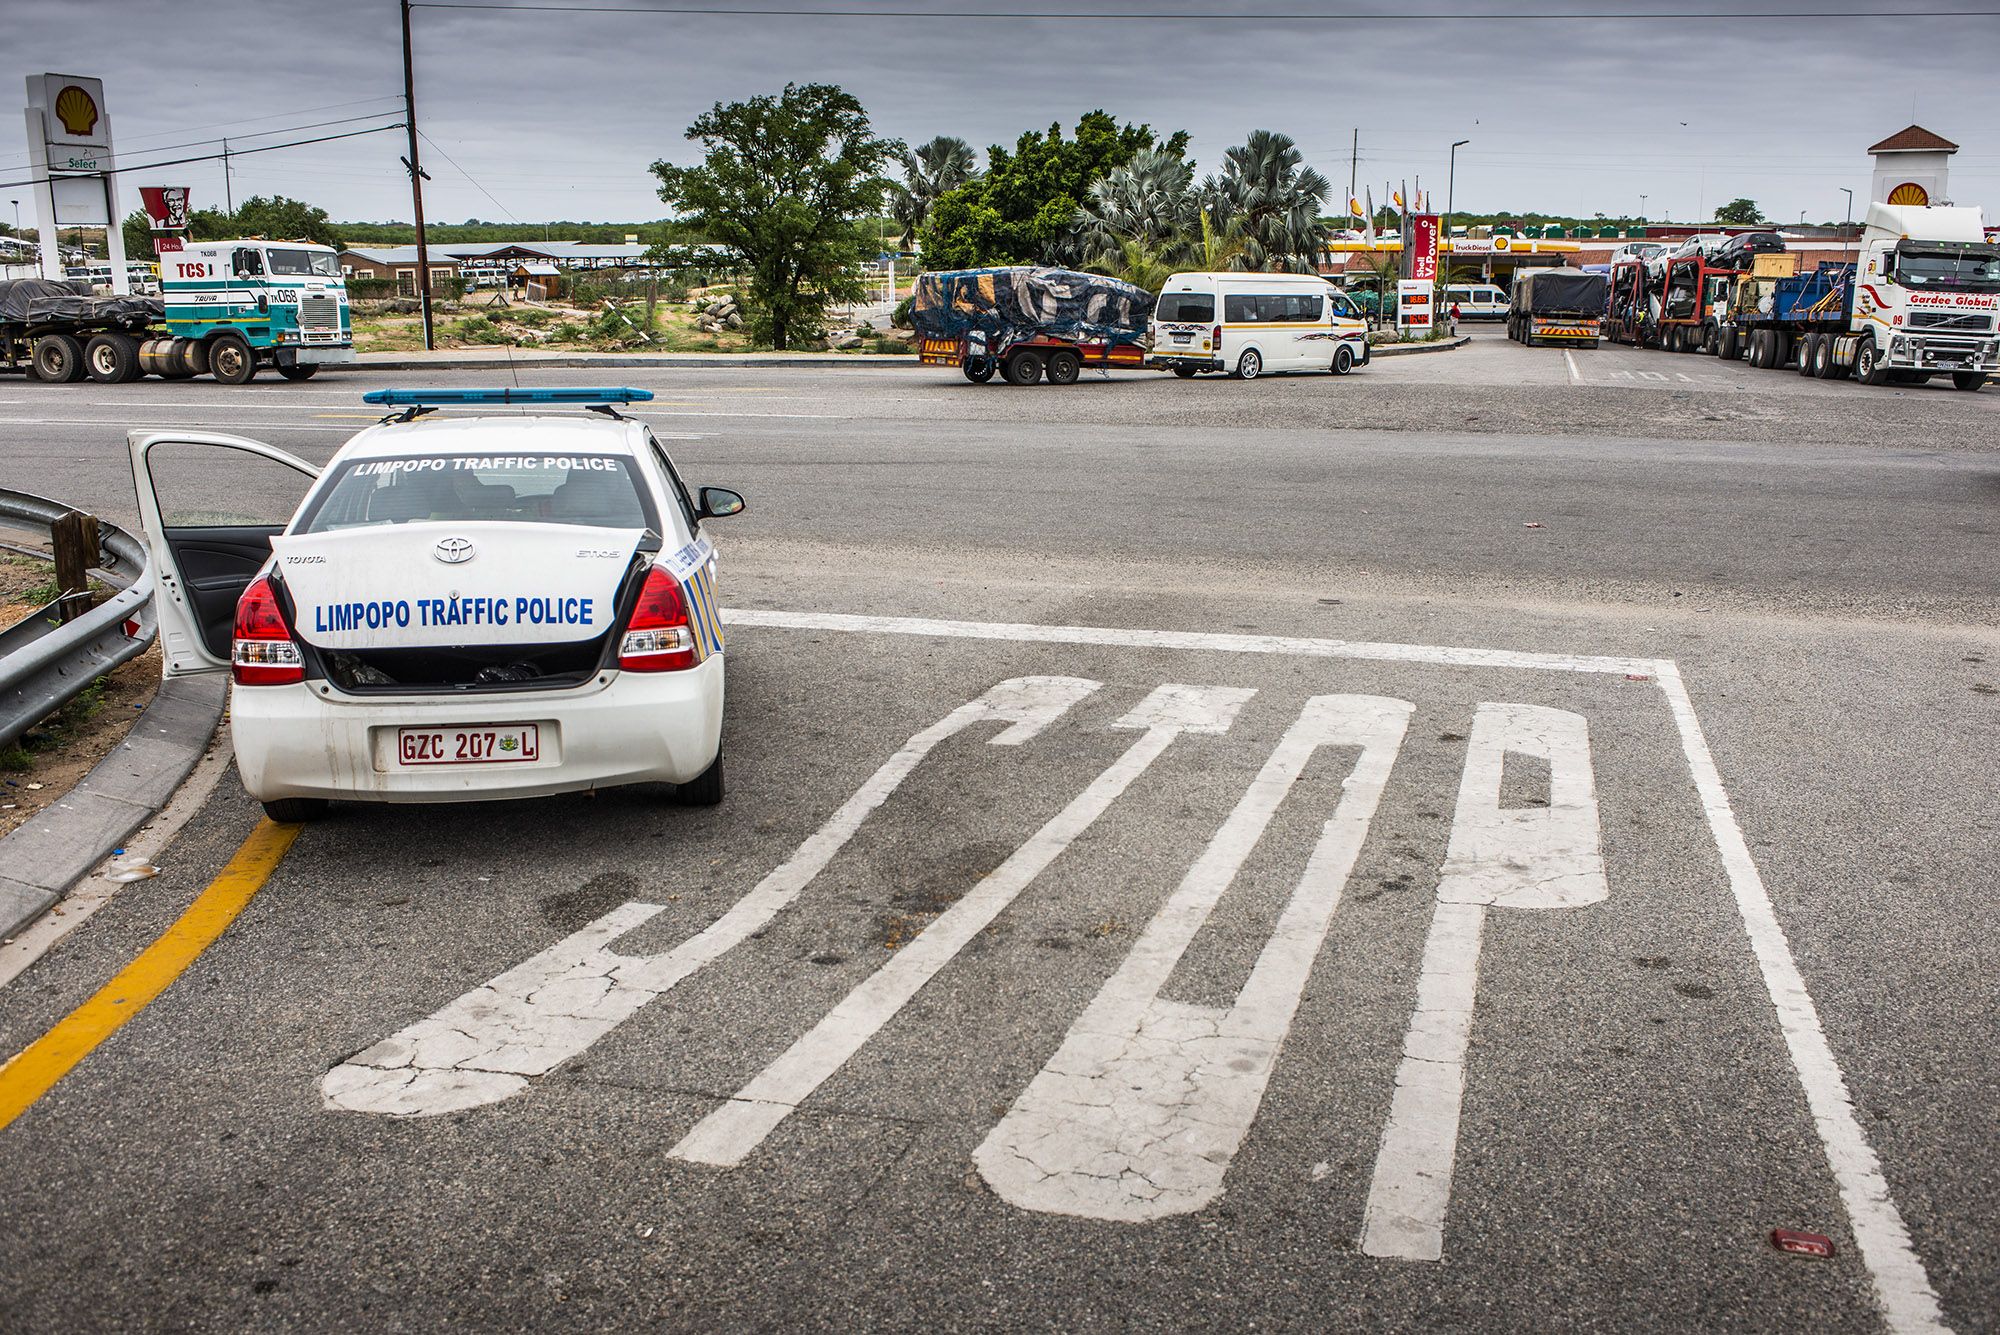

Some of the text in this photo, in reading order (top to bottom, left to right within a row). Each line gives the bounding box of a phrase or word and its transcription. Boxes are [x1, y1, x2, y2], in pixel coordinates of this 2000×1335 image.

[69, 158, 96, 168] Select
[1424, 223, 1437, 277] V-Power
[176, 263, 205, 277] TCS
[1416, 256, 1425, 278] Shell
[270, 289, 298, 303] TK068
[1910, 294, 1992, 307] Gardee Global
[1892, 315, 1903, 325] 09
[353, 457, 618, 477] LIMPOPO TRAFFIC POLICE
[286, 555, 326, 564] TOYOTA
[315, 597, 593, 632] LIMPOPO TRAFFIC POLICE
[403, 732, 534, 759] GZC 207 L
[322, 676, 1609, 1262] STOP
